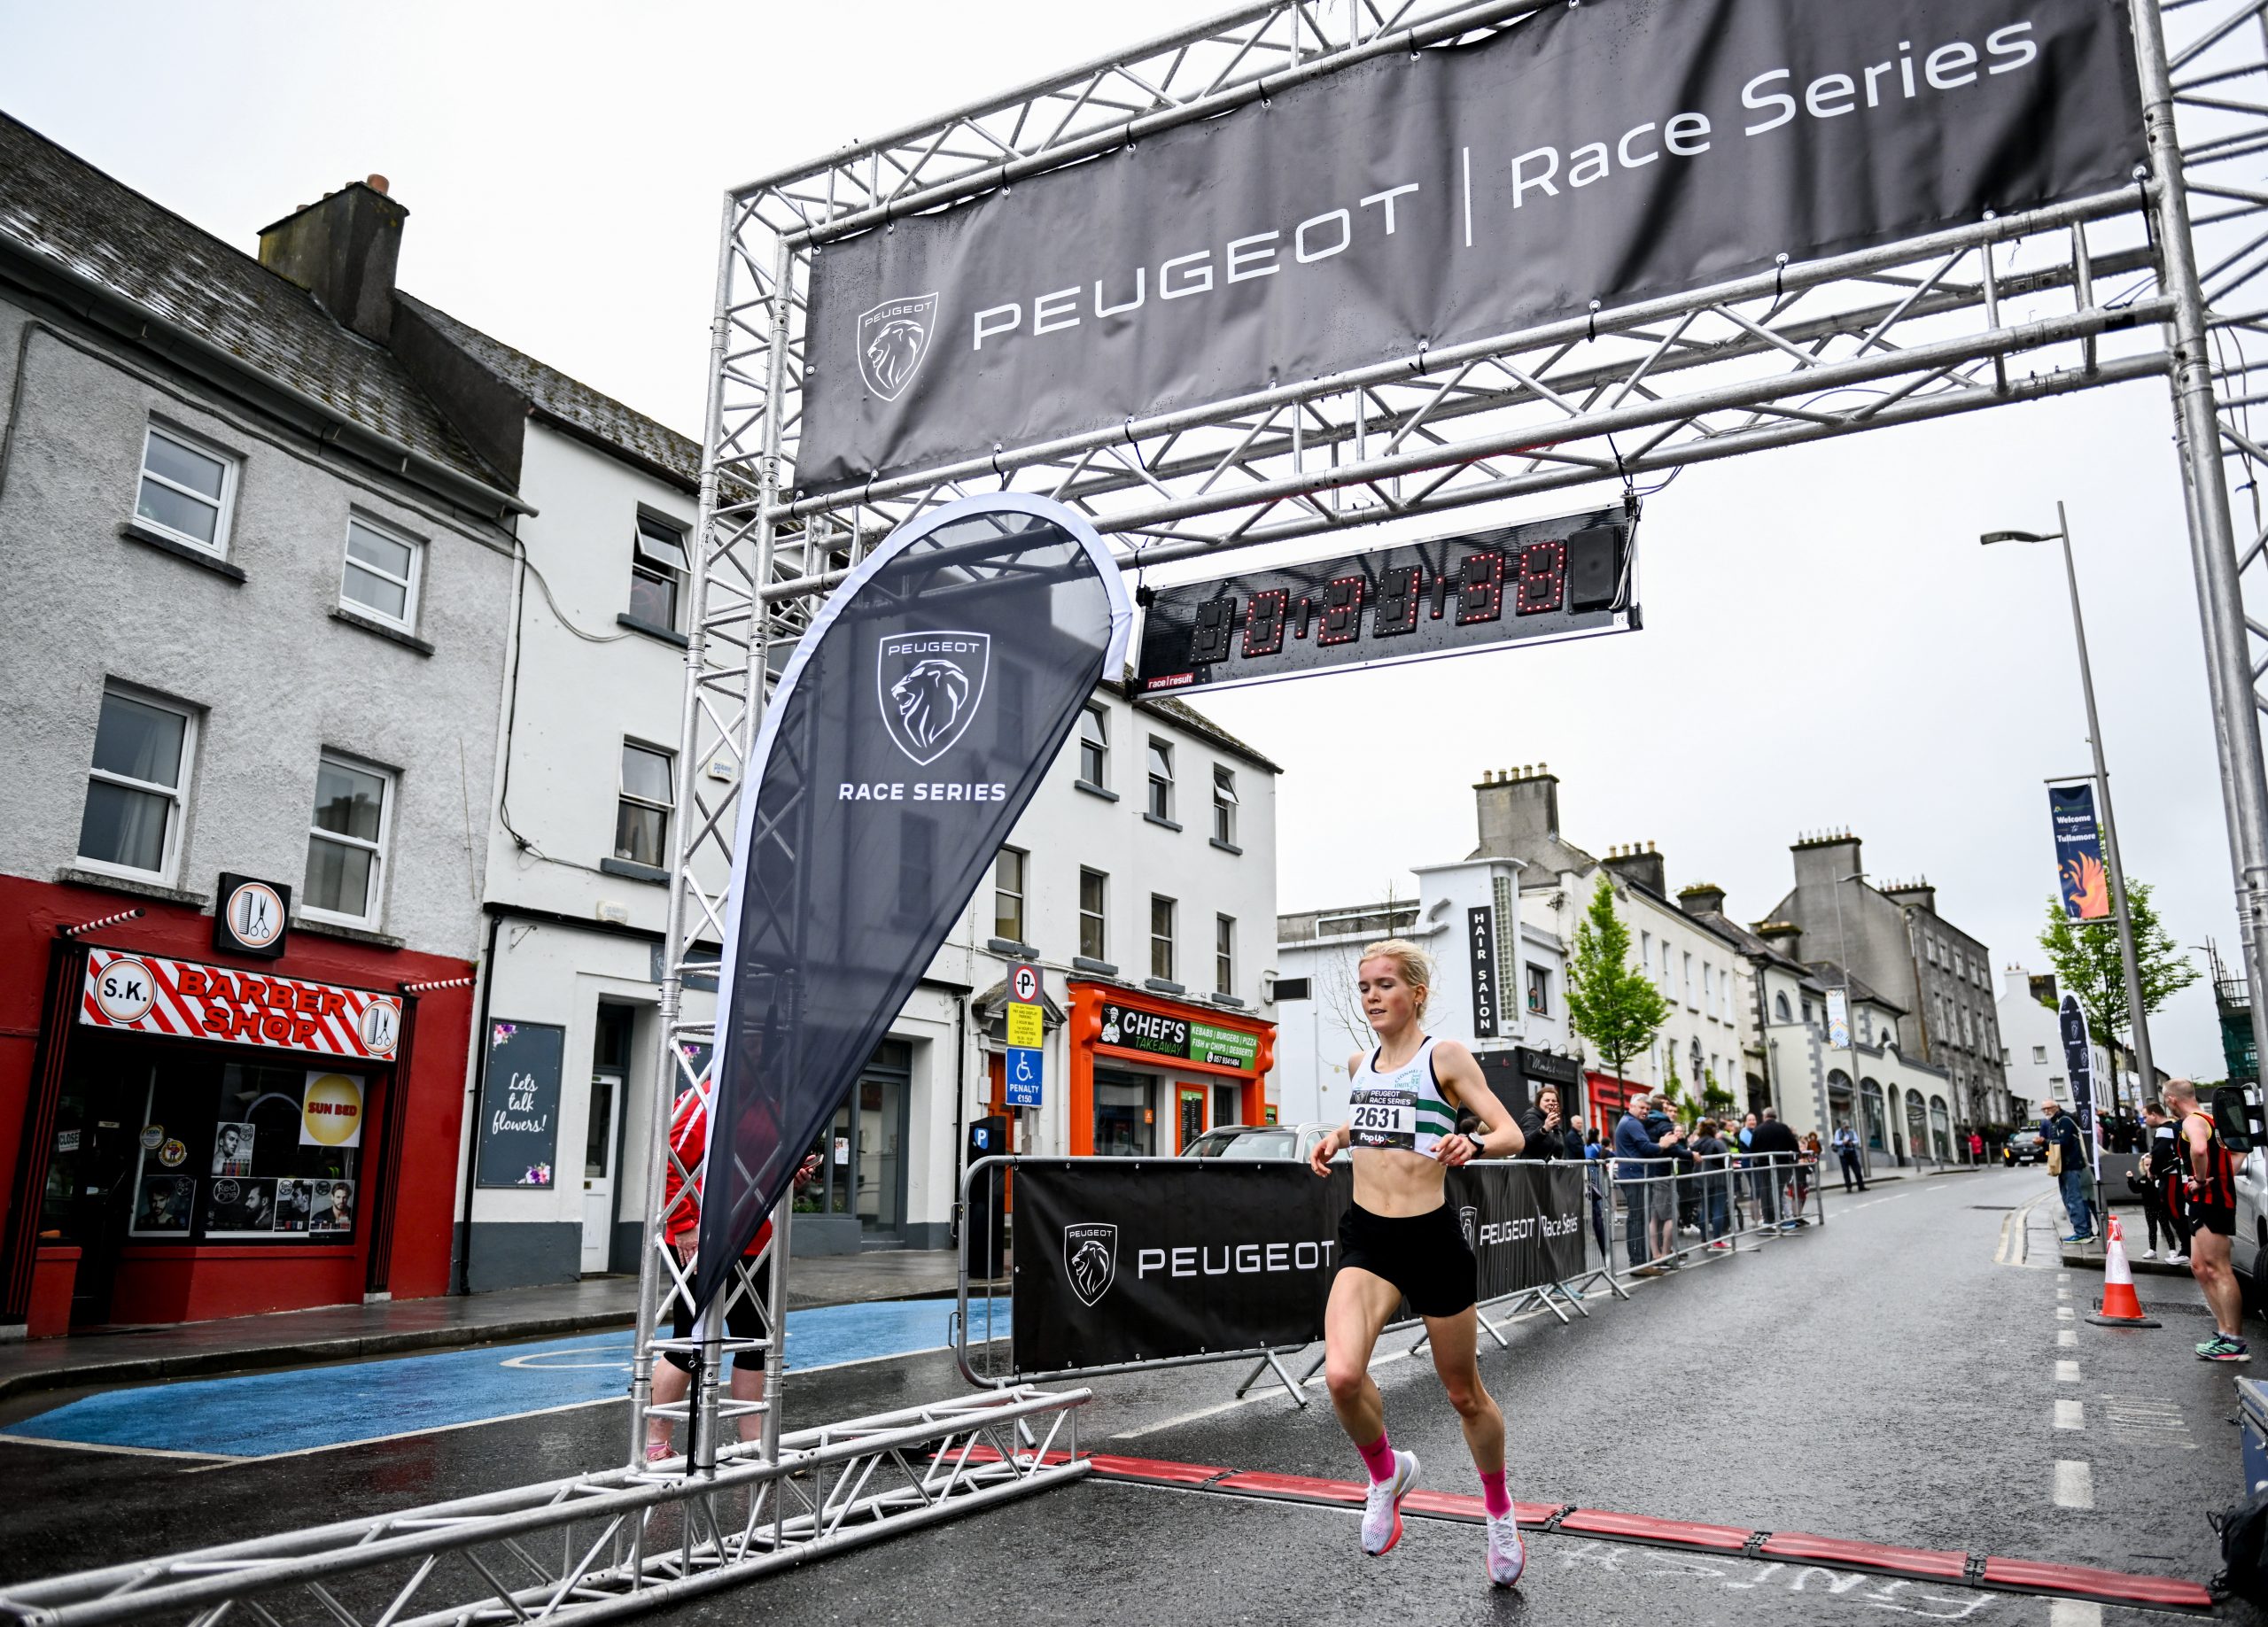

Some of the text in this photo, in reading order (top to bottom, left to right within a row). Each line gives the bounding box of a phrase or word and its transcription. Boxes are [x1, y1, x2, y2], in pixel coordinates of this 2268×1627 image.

[974, 21, 2039, 350] PEUGEOT Race Series
[865, 301, 933, 328] PEUGEOT
[889, 642, 980, 655] PEUGEOT
[838, 783, 1006, 801] RACE SERIES
[2056, 815, 2092, 824] Welcome
[2056, 833, 2096, 842] Tullamore
[1474, 914, 1486, 959] HAIR
[103, 977, 147, 1003] S.K.
[1021, 972, 1030, 994] P
[177, 969, 346, 1019] BARBER
[1478, 970, 1490, 1029] SALON
[202, 1007, 317, 1043] SHOP
[1123, 1011, 1185, 1043] CHEF'S
[1135, 1035, 1183, 1056] TAKEAWAY
[1192, 1026, 1256, 1047] KEBABS BURGERS PIZZA
[1192, 1038, 1205, 1048] FISH
[1211, 1042, 1226, 1052] CHIPS
[1230, 1045, 1253, 1058] DESSERTS
[509, 1073, 538, 1092] Lets
[1009, 1083, 1039, 1094] PENALTY
[508, 1092, 534, 1112] talk
[1017, 1094, 1032, 1104] €150
[308, 1102, 358, 1117] SUN BED
[1354, 1107, 1400, 1129] 2631
[492, 1110, 547, 1135] flowers!
[977, 1129, 987, 1146] P
[1360, 1133, 1375, 1143] Pop
[1375, 1134, 1385, 1144] Up
[216, 1191, 237, 1204] One
[217, 1183, 237, 1192] Red
[1069, 1228, 1114, 1238] PEUGEOT
[1480, 1213, 1578, 1245] PEUGEOT Race Series
[1138, 1240, 1335, 1279] PEUGEOT
